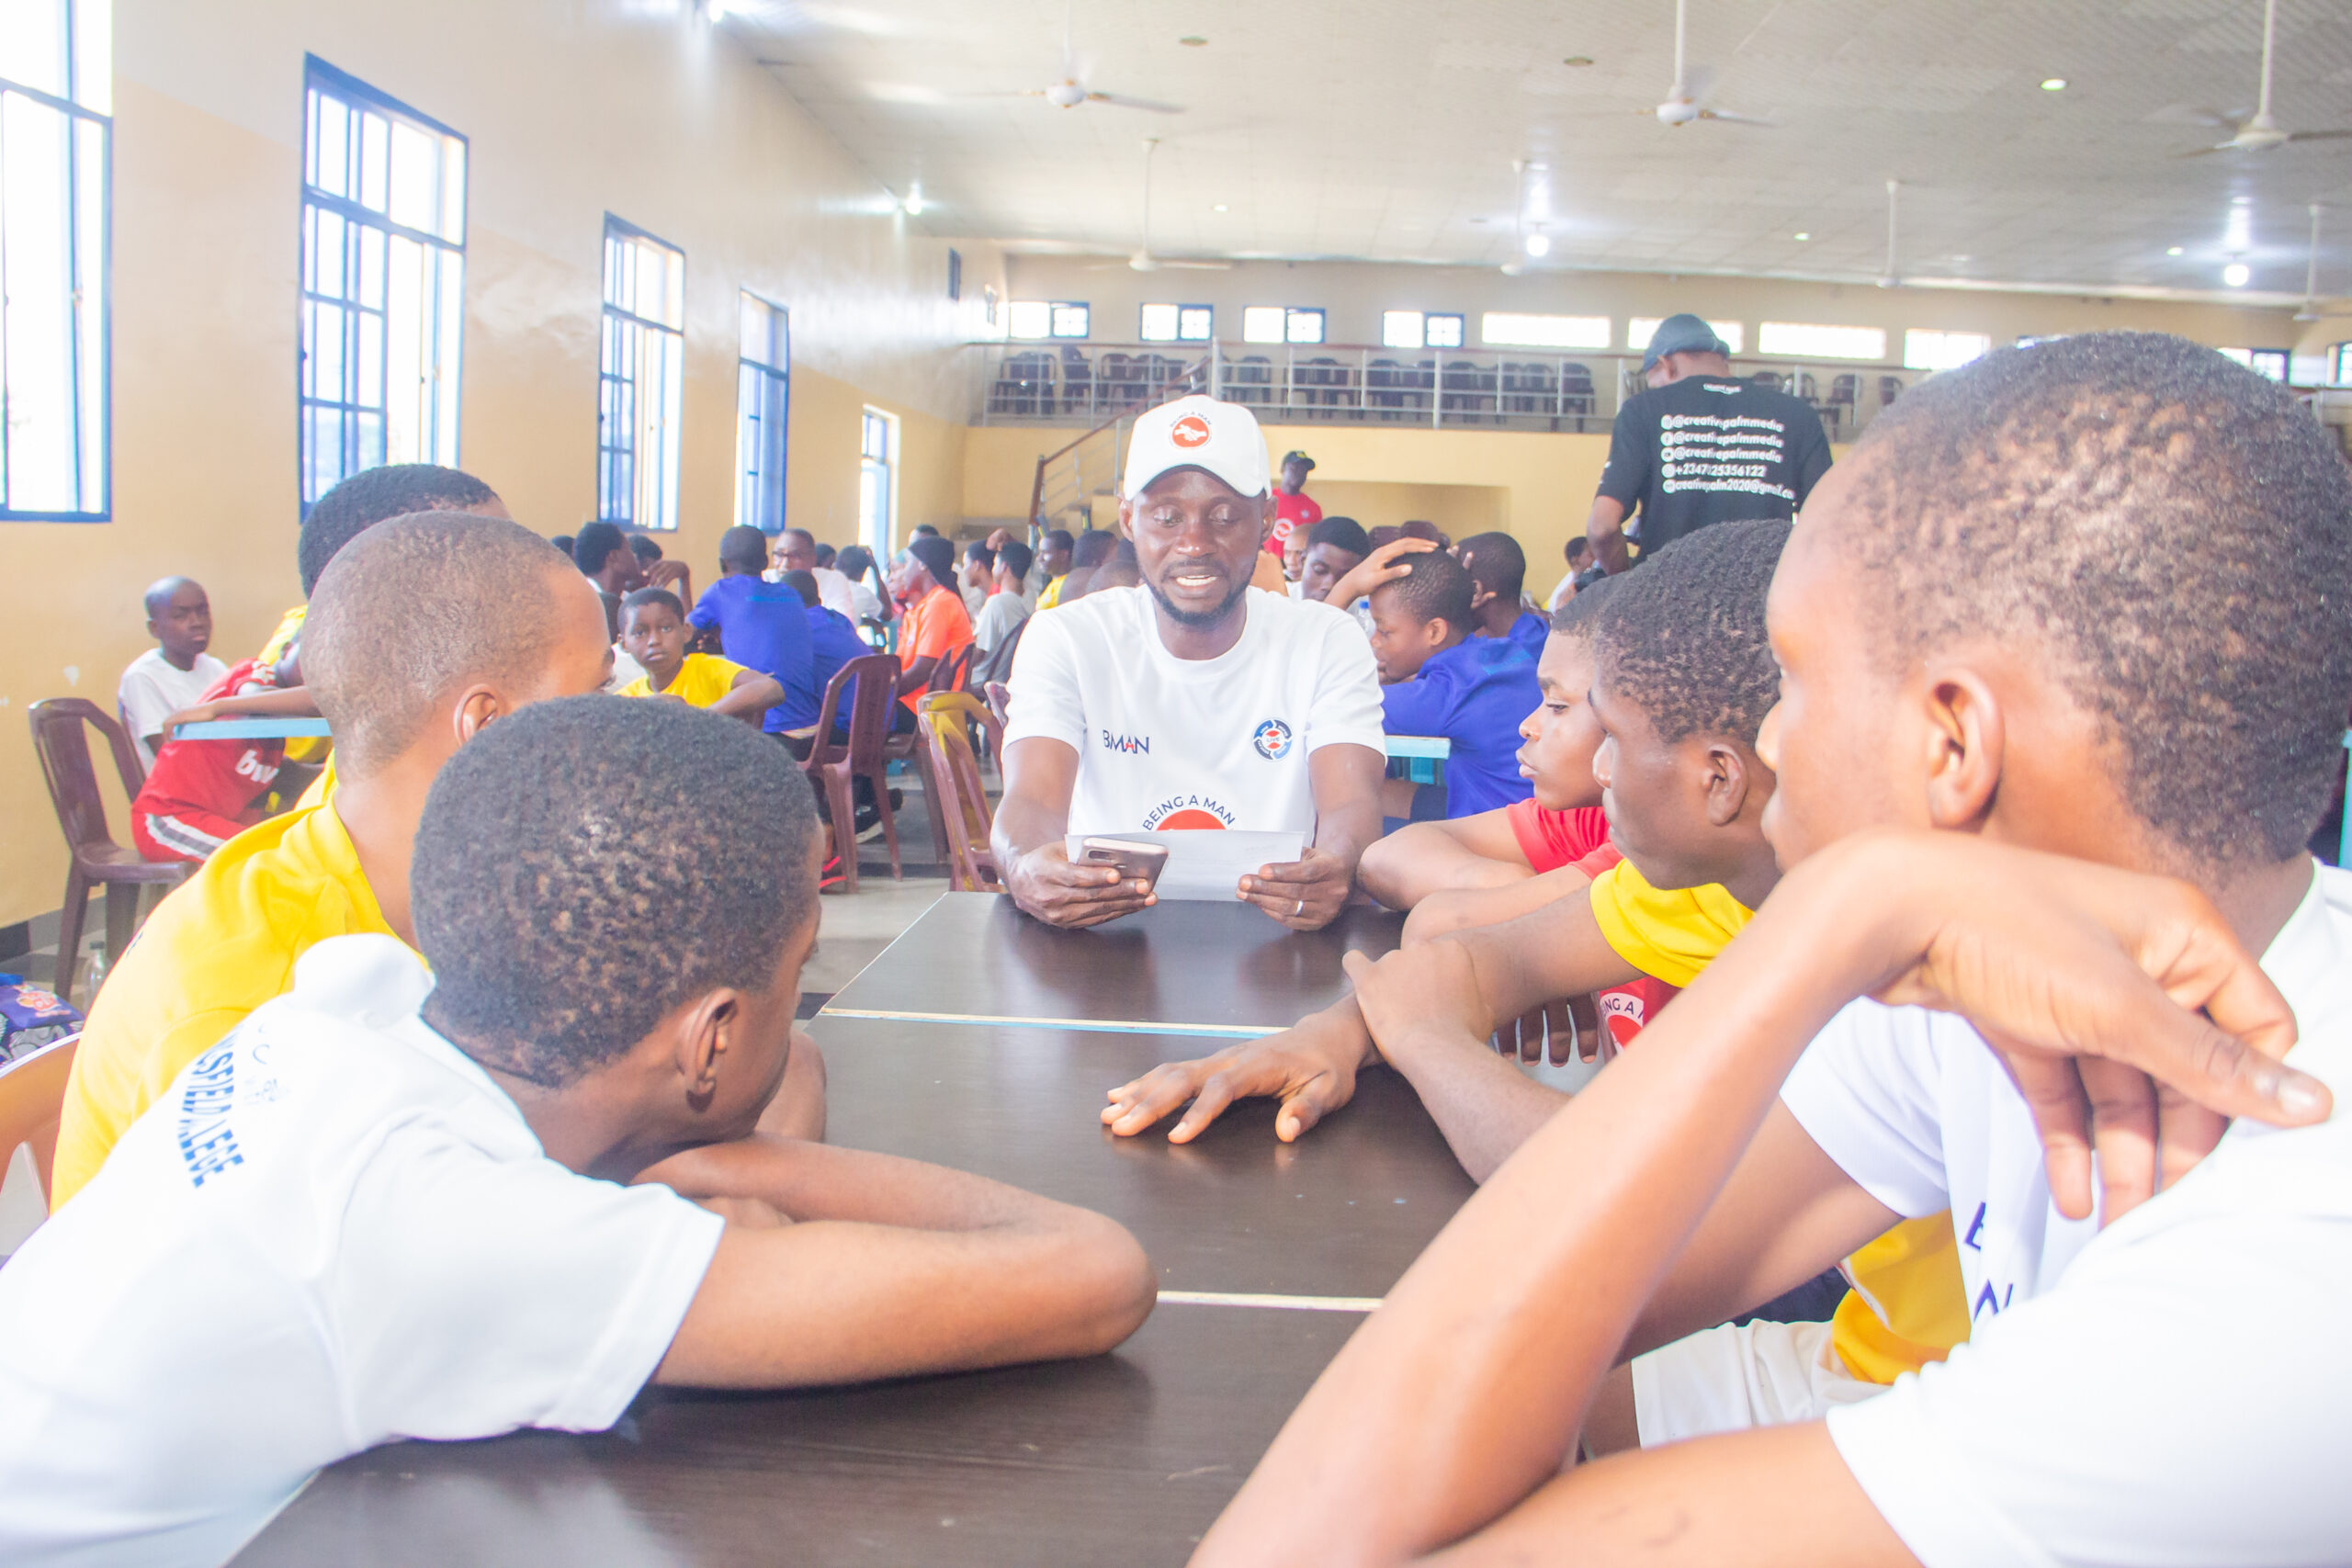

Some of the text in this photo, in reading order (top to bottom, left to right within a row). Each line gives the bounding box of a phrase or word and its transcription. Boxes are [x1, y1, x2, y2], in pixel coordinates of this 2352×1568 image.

[1102, 729, 1149, 755] BMAN
[1142, 795, 1236, 831] BEING A MAN
[1623, 1000, 1634, 1015] A
